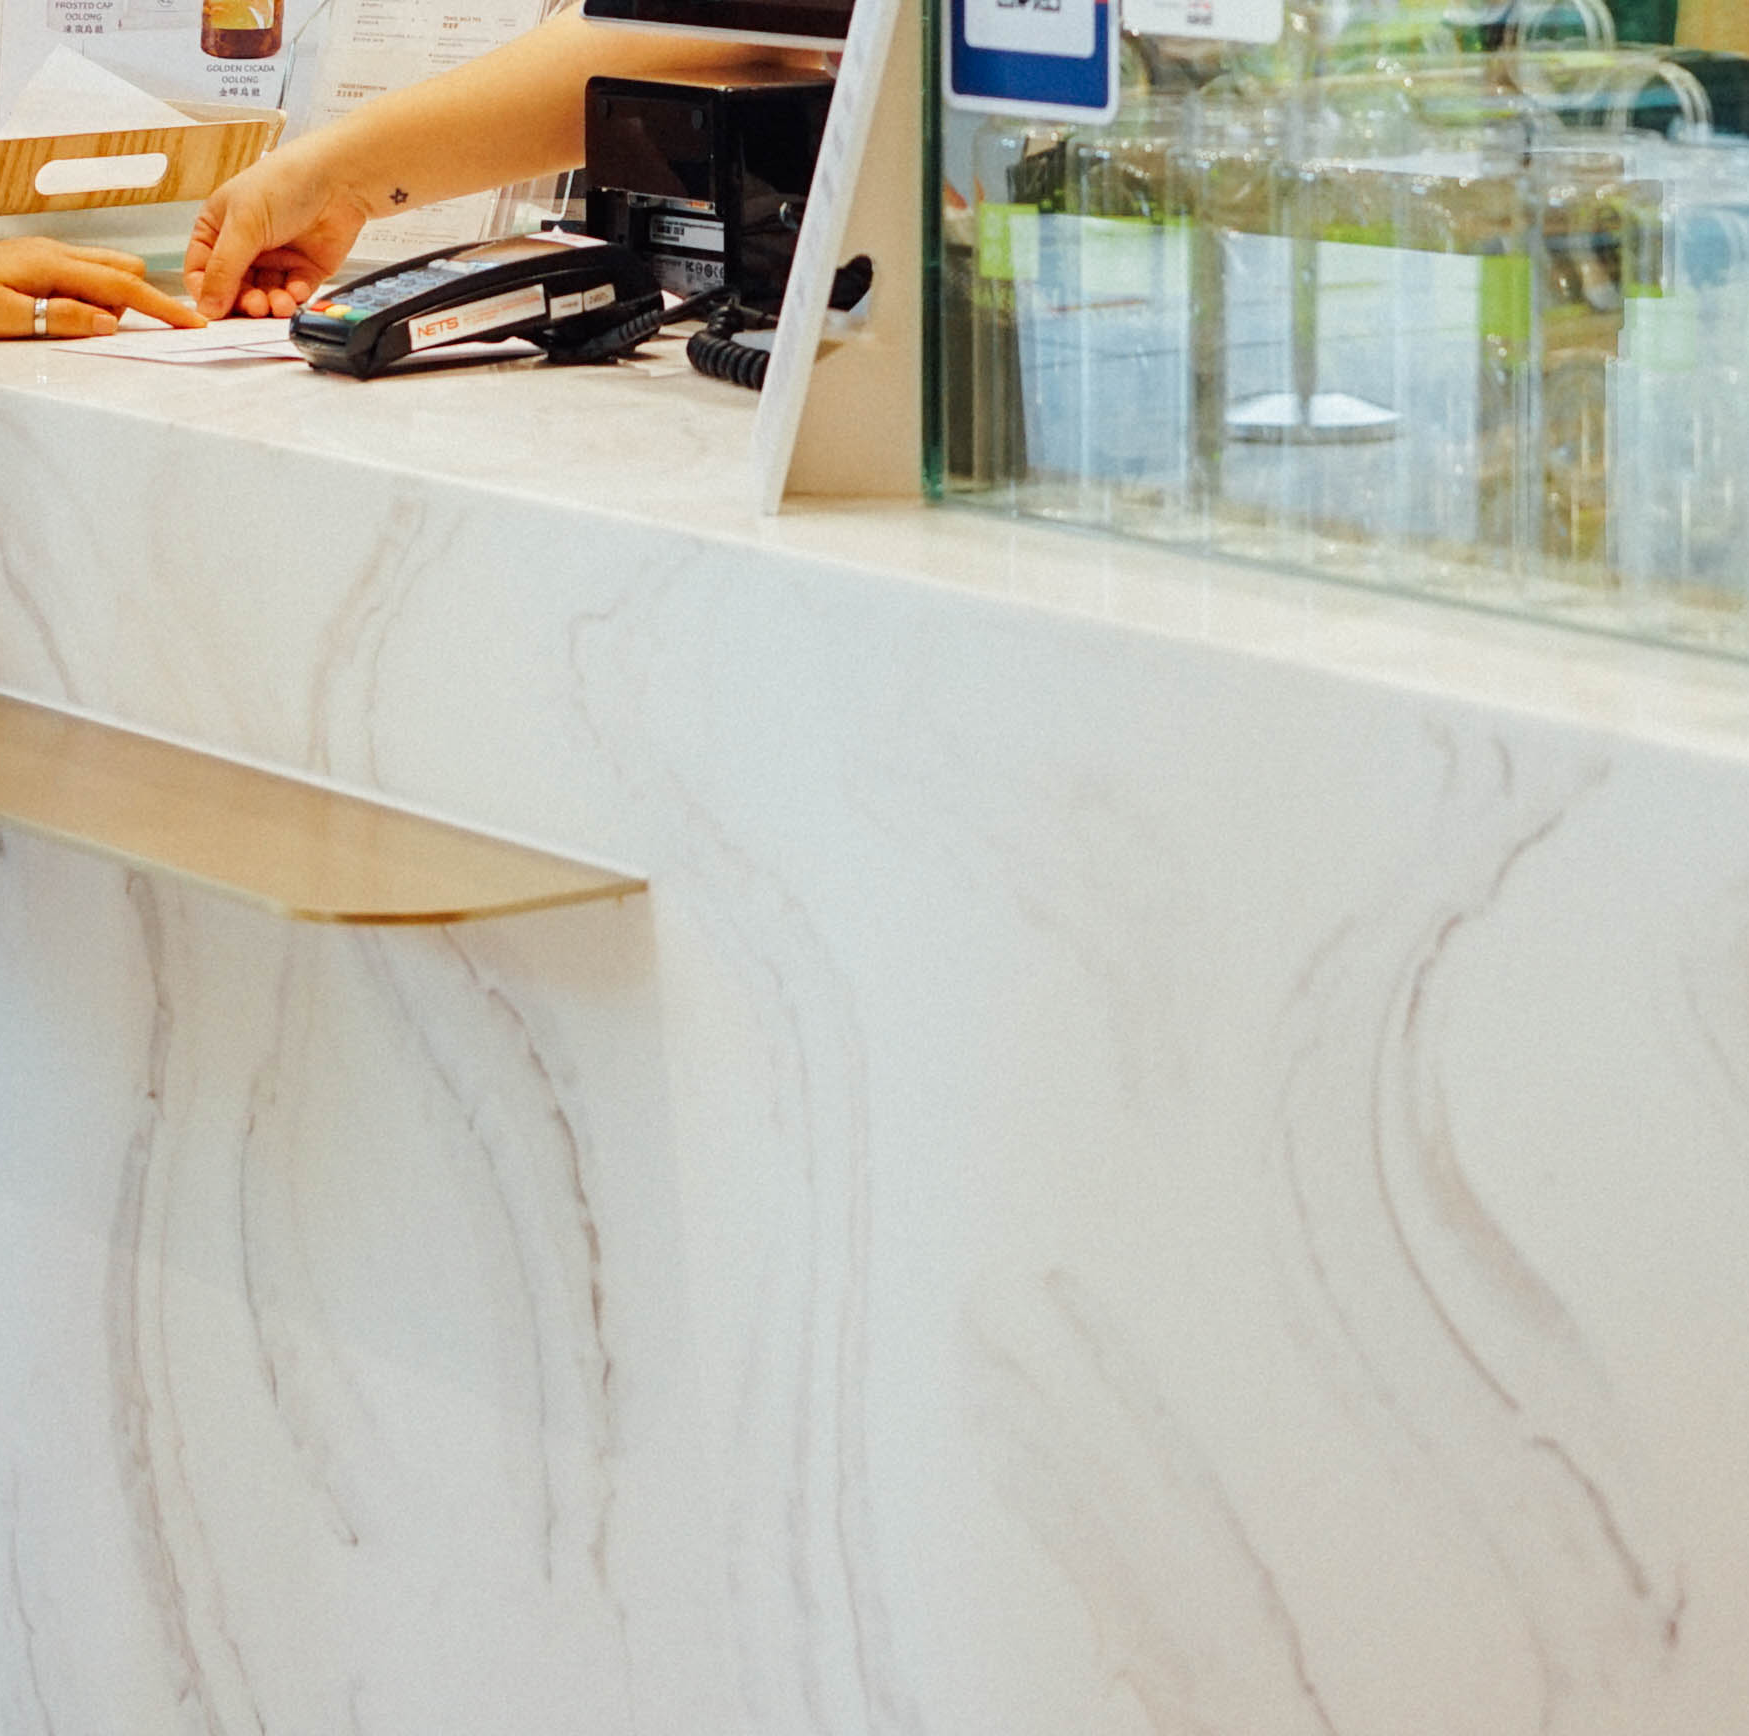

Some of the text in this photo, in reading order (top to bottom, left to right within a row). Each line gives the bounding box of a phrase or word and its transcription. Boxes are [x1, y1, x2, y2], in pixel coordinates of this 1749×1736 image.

[55, 1, 113, 10] FROSTED CAP
[65, 12, 103, 21] OOLONG
[206, 64, 275, 73] GOLDEN CICADA
[221, 75, 259, 84] OOLONG
[417, 316, 459, 339] NETS
